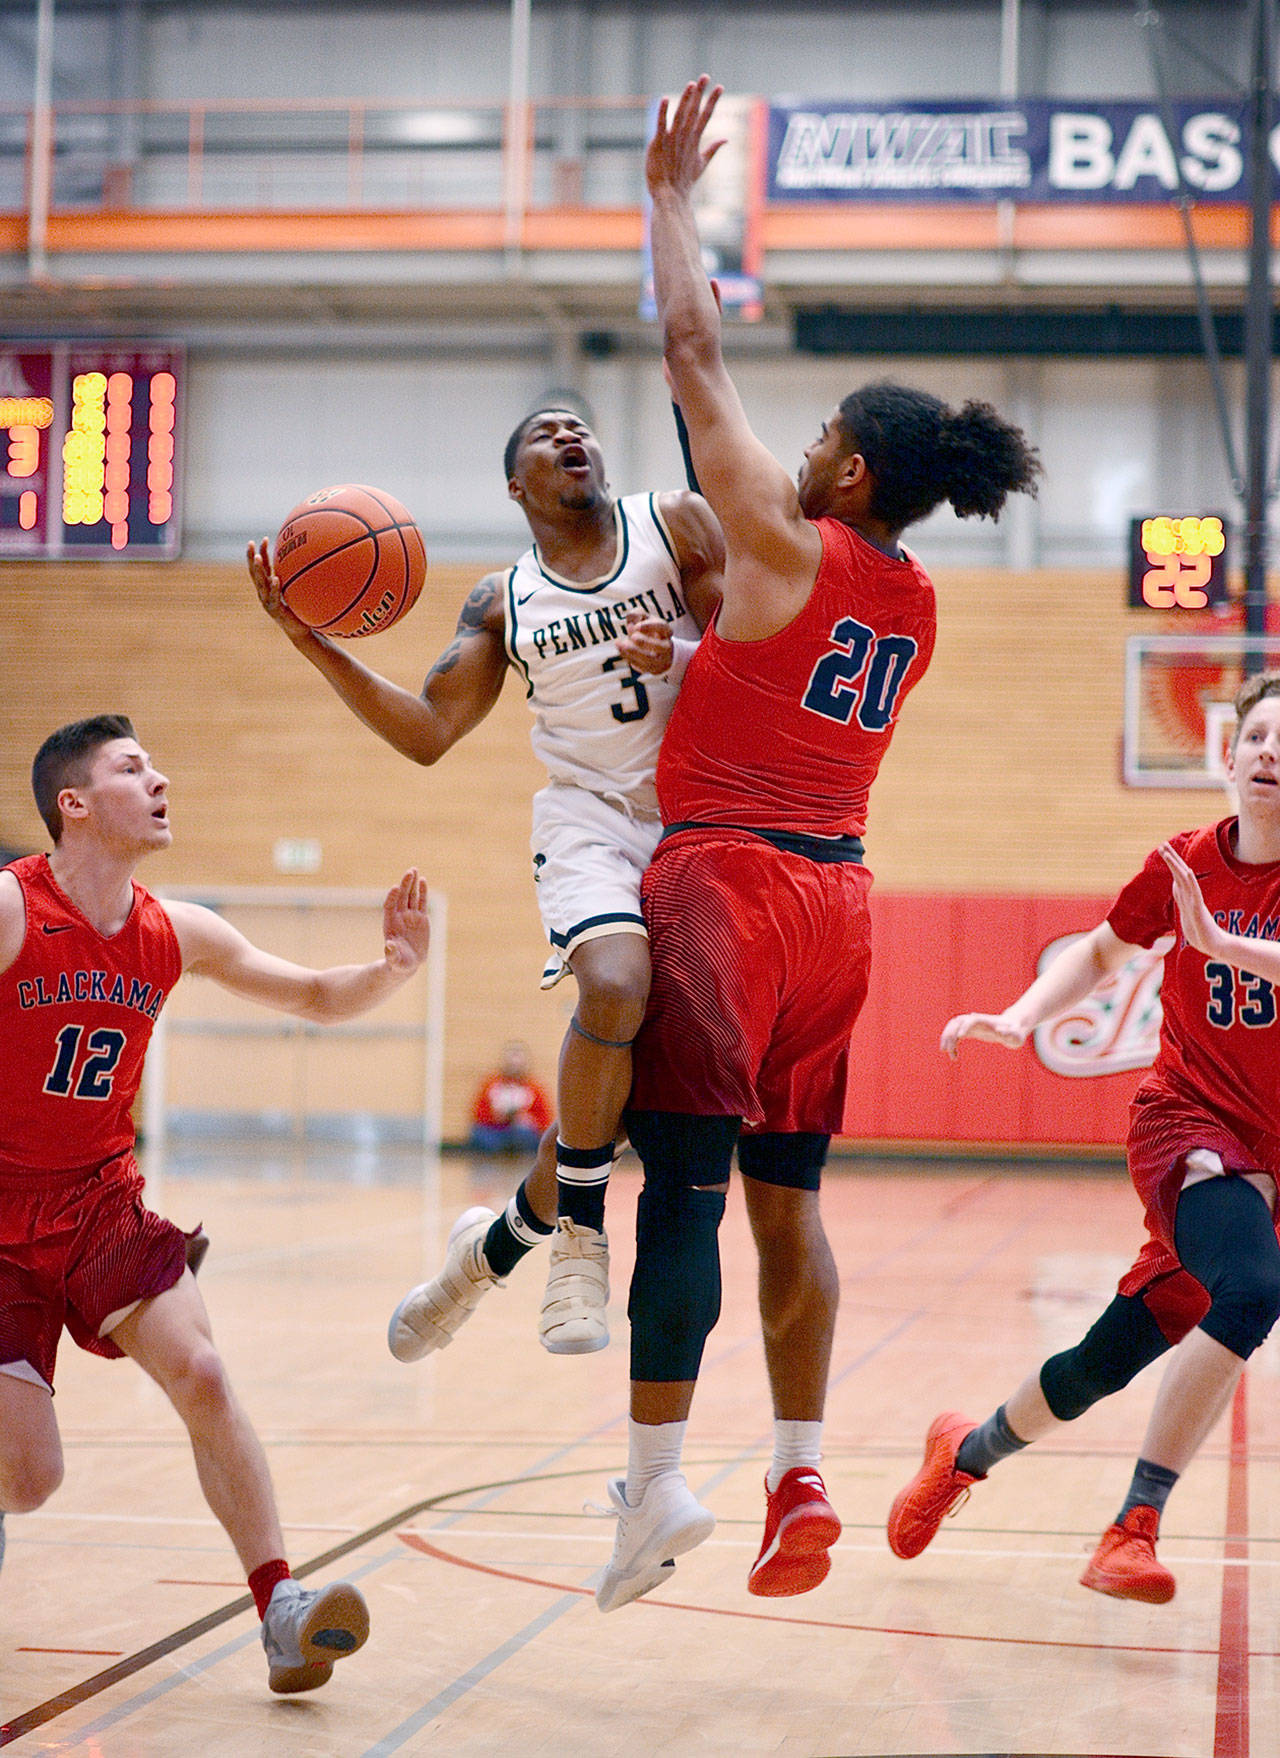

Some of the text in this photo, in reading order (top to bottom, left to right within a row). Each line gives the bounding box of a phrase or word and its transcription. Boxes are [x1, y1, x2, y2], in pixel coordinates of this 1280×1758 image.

[602, 655, 649, 723] 3
[800, 616, 918, 733] 20
[18, 970, 164, 1021] CLACKAMA
[1204, 960, 1277, 1030] 33
[42, 1023, 127, 1101] 12
